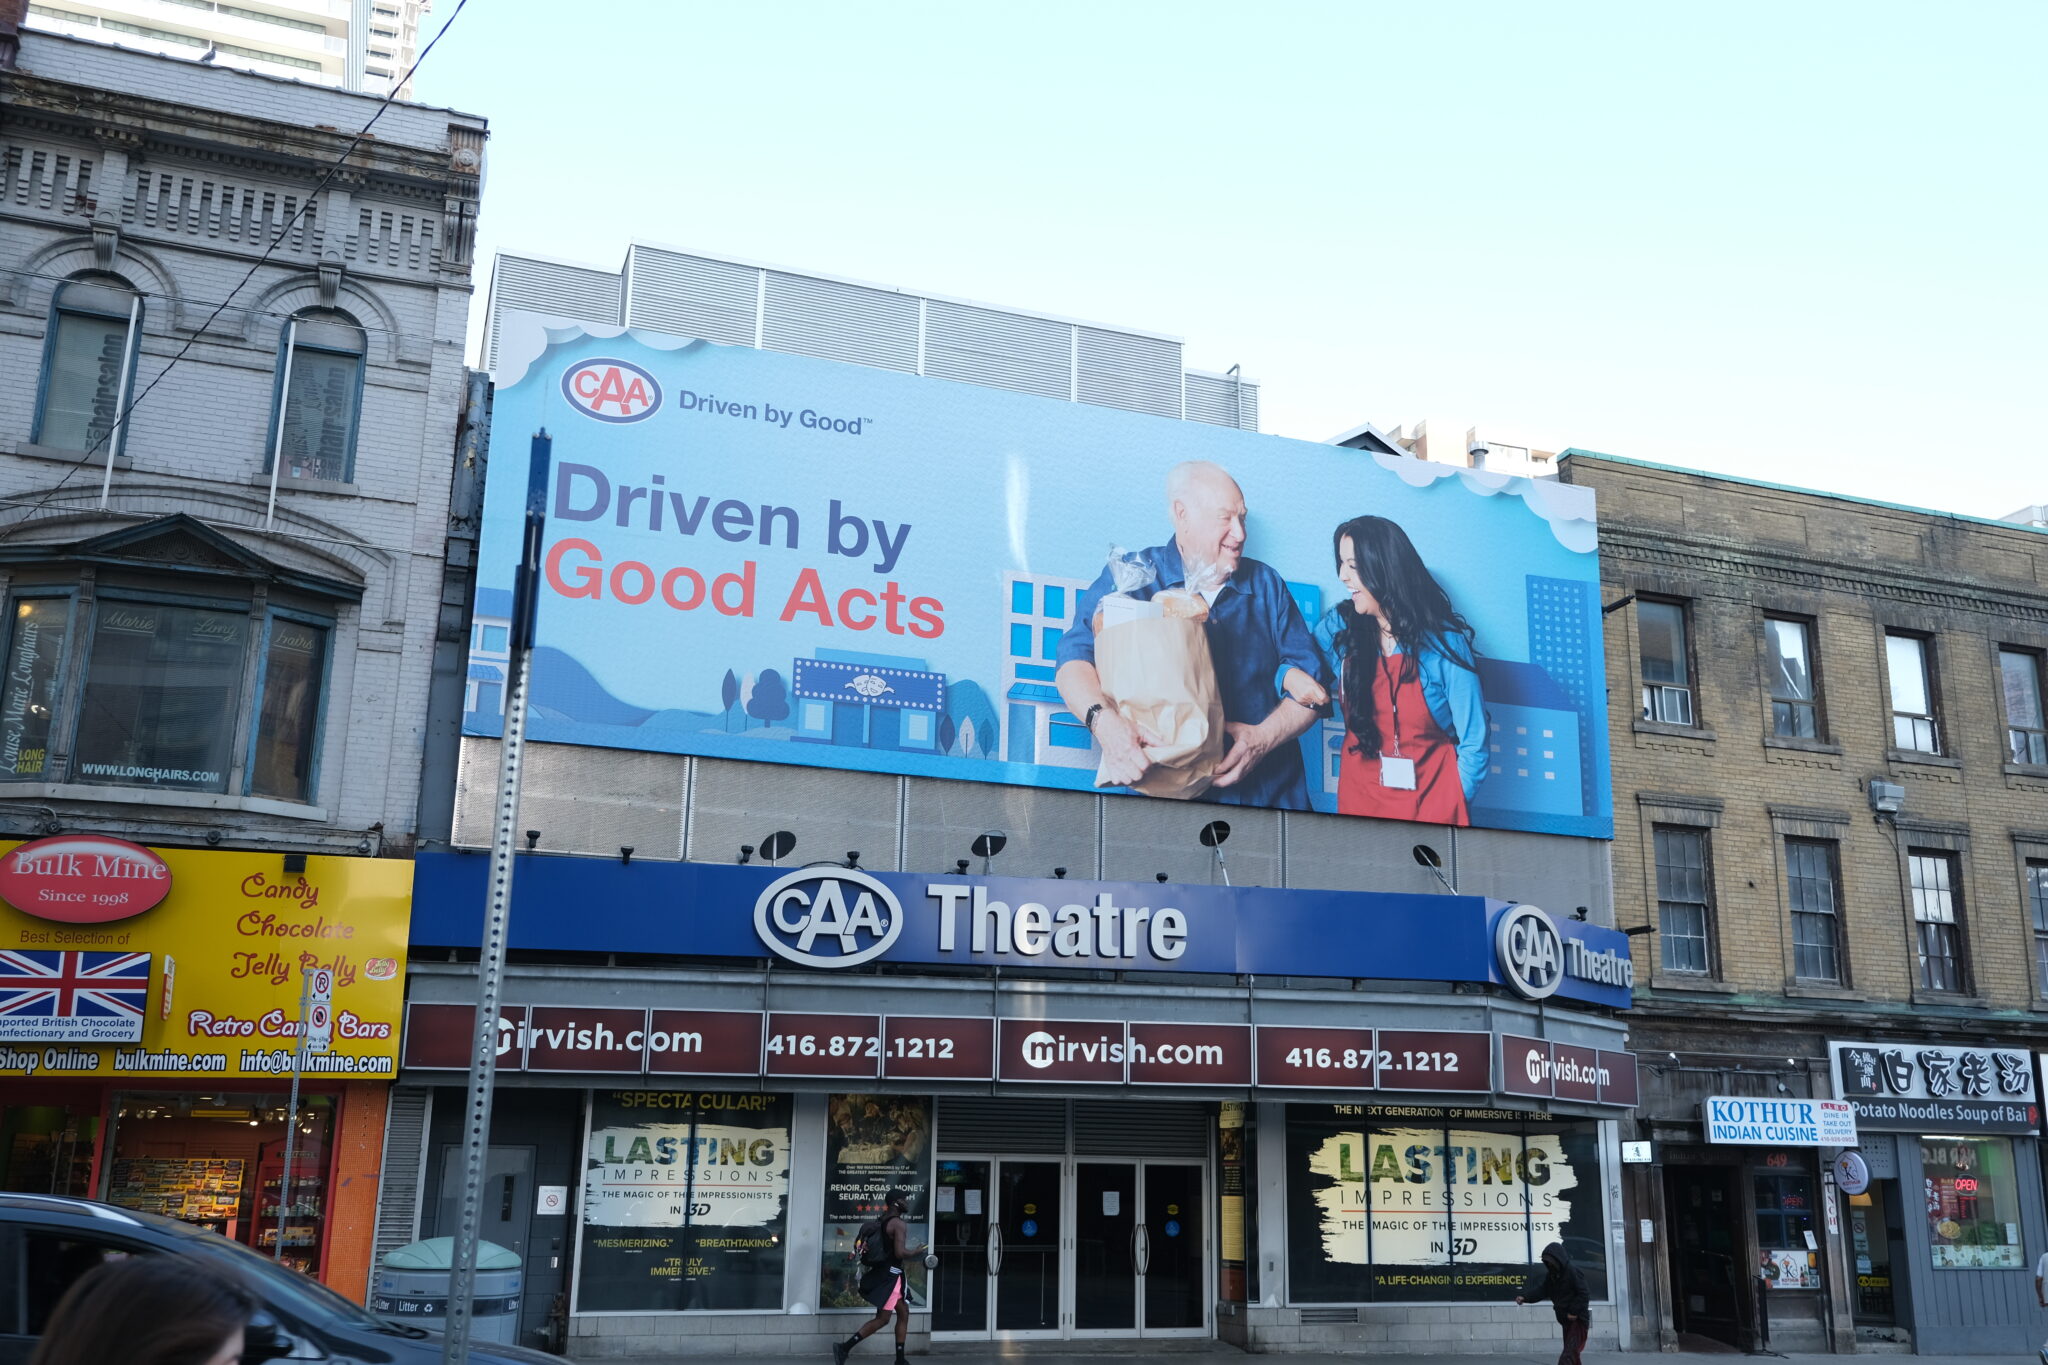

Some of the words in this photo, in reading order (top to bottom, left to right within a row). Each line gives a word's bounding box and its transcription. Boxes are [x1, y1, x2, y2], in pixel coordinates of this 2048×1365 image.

[574, 367, 650, 415] CAA
[679, 390, 758, 420] Driven
[764, 408, 793, 429] by
[554, 461, 800, 549] Driven
[827, 499, 912, 574] by
[545, 537, 757, 618] Good
[779, 567, 945, 639] Acts
[12, 621, 39, 686] Longhairs
[4, 686, 29, 731] Marie
[18, 749, 45, 761] LONG
[16, 761, 44, 774] HAIR
[82, 763, 220, 783] WWW.LONGHAIRS.COM
[12, 851, 83, 877] Bulk
[92, 854, 166, 880] Mine
[38, 889, 86, 902] Since
[92, 892, 129, 906] 1998
[241, 872, 319, 909] Candy
[236, 910, 355, 939] Chocolate
[773, 880, 886, 954] CAA
[927, 884, 1188, 961] Theatre
[20, 930, 50, 943] Best
[54, 930, 114, 944] Selection
[117, 932, 131, 945] of
[1510, 917, 1558, 986] CAA
[1567, 937, 1634, 989] Theatre
[231, 951, 290, 985] Jelly
[0, 1018, 38, 1028] ported
[42, 1017, 78, 1027] British
[81, 1018, 136, 1027] Chocolate
[188, 1009, 255, 1037] Retro
[337, 1010, 392, 1038] Bars
[68, 1028, 86, 1038] and
[91, 1029, 135, 1040] Grocery
[767, 1034, 954, 1059] 416.872.1212
[1022, 1031, 1223, 1068] mirvish.com
[0, 1047, 39, 1075] Shop
[44, 1048, 99, 1070] Online
[114, 1049, 227, 1072] bulkmine.com
[1285, 1047, 1459, 1072] 416.872.1212
[1526, 1049, 1610, 1086] mirvish.com
[1334, 1105, 1352, 1115] THE
[1384, 1106, 1444, 1117] GENERATION
[1449, 1108, 1463, 1118] OF
[1464, 1109, 1513, 1120] IMMERSIVE
[1528, 1111, 1553, 1121] HERE
[1711, 1100, 1816, 1125] KOTHUR
[1853, 1103, 1897, 1118] Potato
[1899, 1104, 1955, 1119] Noodles
[1956, 1108, 1991, 1124] Soup
[1993, 1106, 2004, 1121] of
[2007, 1107, 2027, 1122] Bai
[1713, 1125, 1762, 1140] INDIAN
[1765, 1126, 1818, 1142] CUISINE
[605, 1136, 775, 1167] LASTING
[1766, 1153, 1787, 1167] 649
[1340, 1143, 1551, 1187] LASTING
[602, 1169, 773, 1182] IMPRESSIONS
[1955, 1179, 1977, 1191] OPEN
[602, 1191, 621, 1199] THE
[624, 1191, 654, 1199] MAGIC
[657, 1191, 670, 1199] OF
[673, 1191, 695, 1199] THE
[697, 1192, 773, 1200] IMPRESSIONISTS
[830, 1184, 862, 1193] RENOIR,
[838, 1193, 871, 1201] SEURAT,
[1341, 1189, 1552, 1207] IMPRESSIONS
[670, 1205, 681, 1215] IN
[687, 1203, 711, 1216] 3D
[1342, 1220, 1365, 1230] THE
[1372, 1220, 1409, 1231] MAGIC
[1413, 1221, 1428, 1230] OF
[1432, 1221, 1457, 1231] THE
[1460, 1221, 1554, 1232] IMPRESSIONISTS
[593, 1239, 673, 1248] "MESMERIZING."
[695, 1239, 776, 1248] "BREATHTAKING.
[1430, 1241, 1443, 1253] IN
[1450, 1238, 1477, 1255] 3D
[1388, 1275, 1463, 1285] LIFE-CHANGING
[1465, 1275, 1527, 1286] EXPERIENCE."
[398, 1301, 419, 1313] Litter
